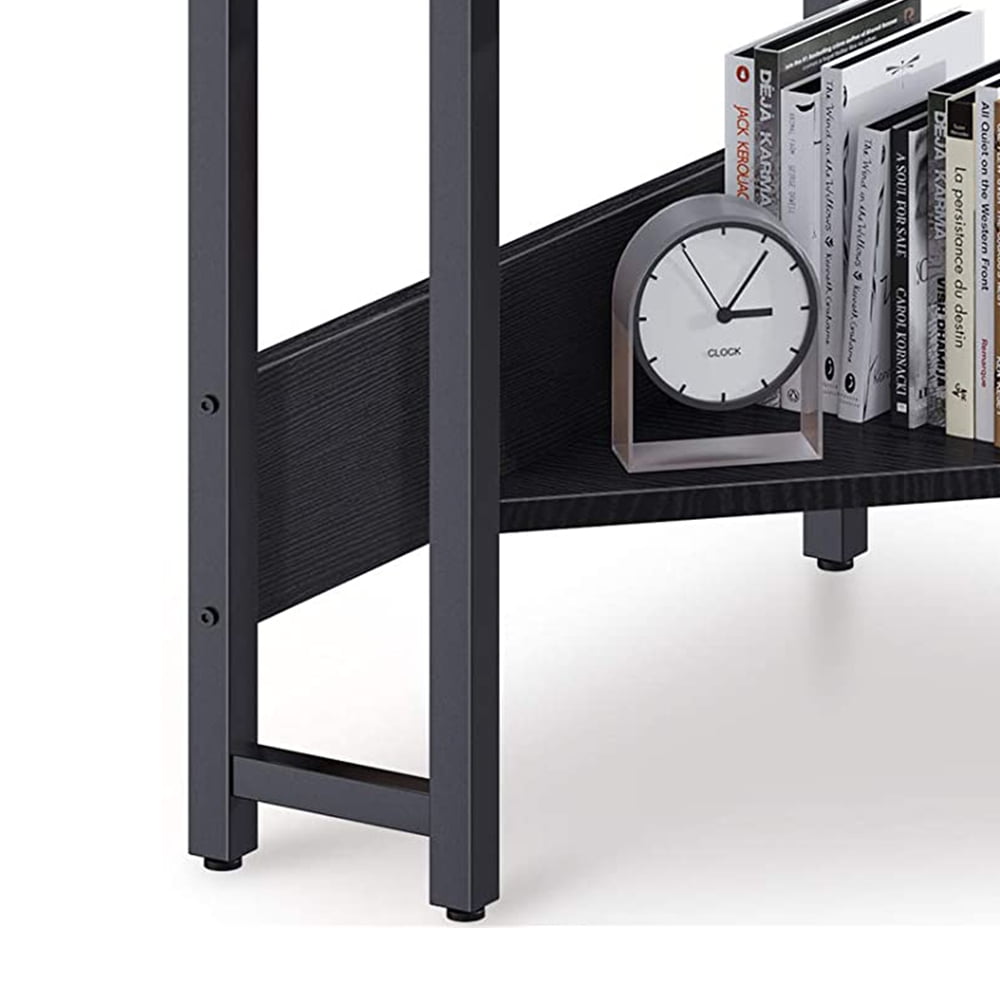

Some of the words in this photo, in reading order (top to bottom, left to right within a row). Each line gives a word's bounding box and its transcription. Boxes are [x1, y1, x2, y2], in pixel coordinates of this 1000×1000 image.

[825, 81, 834, 99] The
[733, 103, 750, 136] JACK
[825, 103, 835, 139] Wind
[980, 101, 990, 119] All
[825, 143, 832, 156] in
[863, 139, 873, 156] The
[980, 121, 991, 156] Quiet
[736, 140, 750, 201] KEROUAC
[760, 130, 773, 208] KARMA
[825, 159, 834, 178] the
[895, 152, 907, 162] A
[980, 159, 988, 176] on
[861, 160, 873, 190] Wind
[895, 164, 907, 197] SOUL
[954, 166, 967, 184] La
[980, 180, 990, 200] the
[857, 205, 867, 222] the
[895, 200, 907, 227] FOR
[934, 169, 946, 240] KARMA
[895, 227, 907, 258] SALE
[951, 188, 967, 275] persistance
[980, 203, 990, 254] Western
[954, 279, 968, 299] du
[980, 258, 991, 291] Front
[895, 287, 907, 331] CAROL
[936, 278, 946, 315] VISH
[954, 303, 968, 349] destin
[707, 346, 742, 358] CLOCK
[895, 332, 907, 396] KORNACKI
[935, 318, 946, 387] DHAMIJA
[980, 338, 989, 388] Remarque
